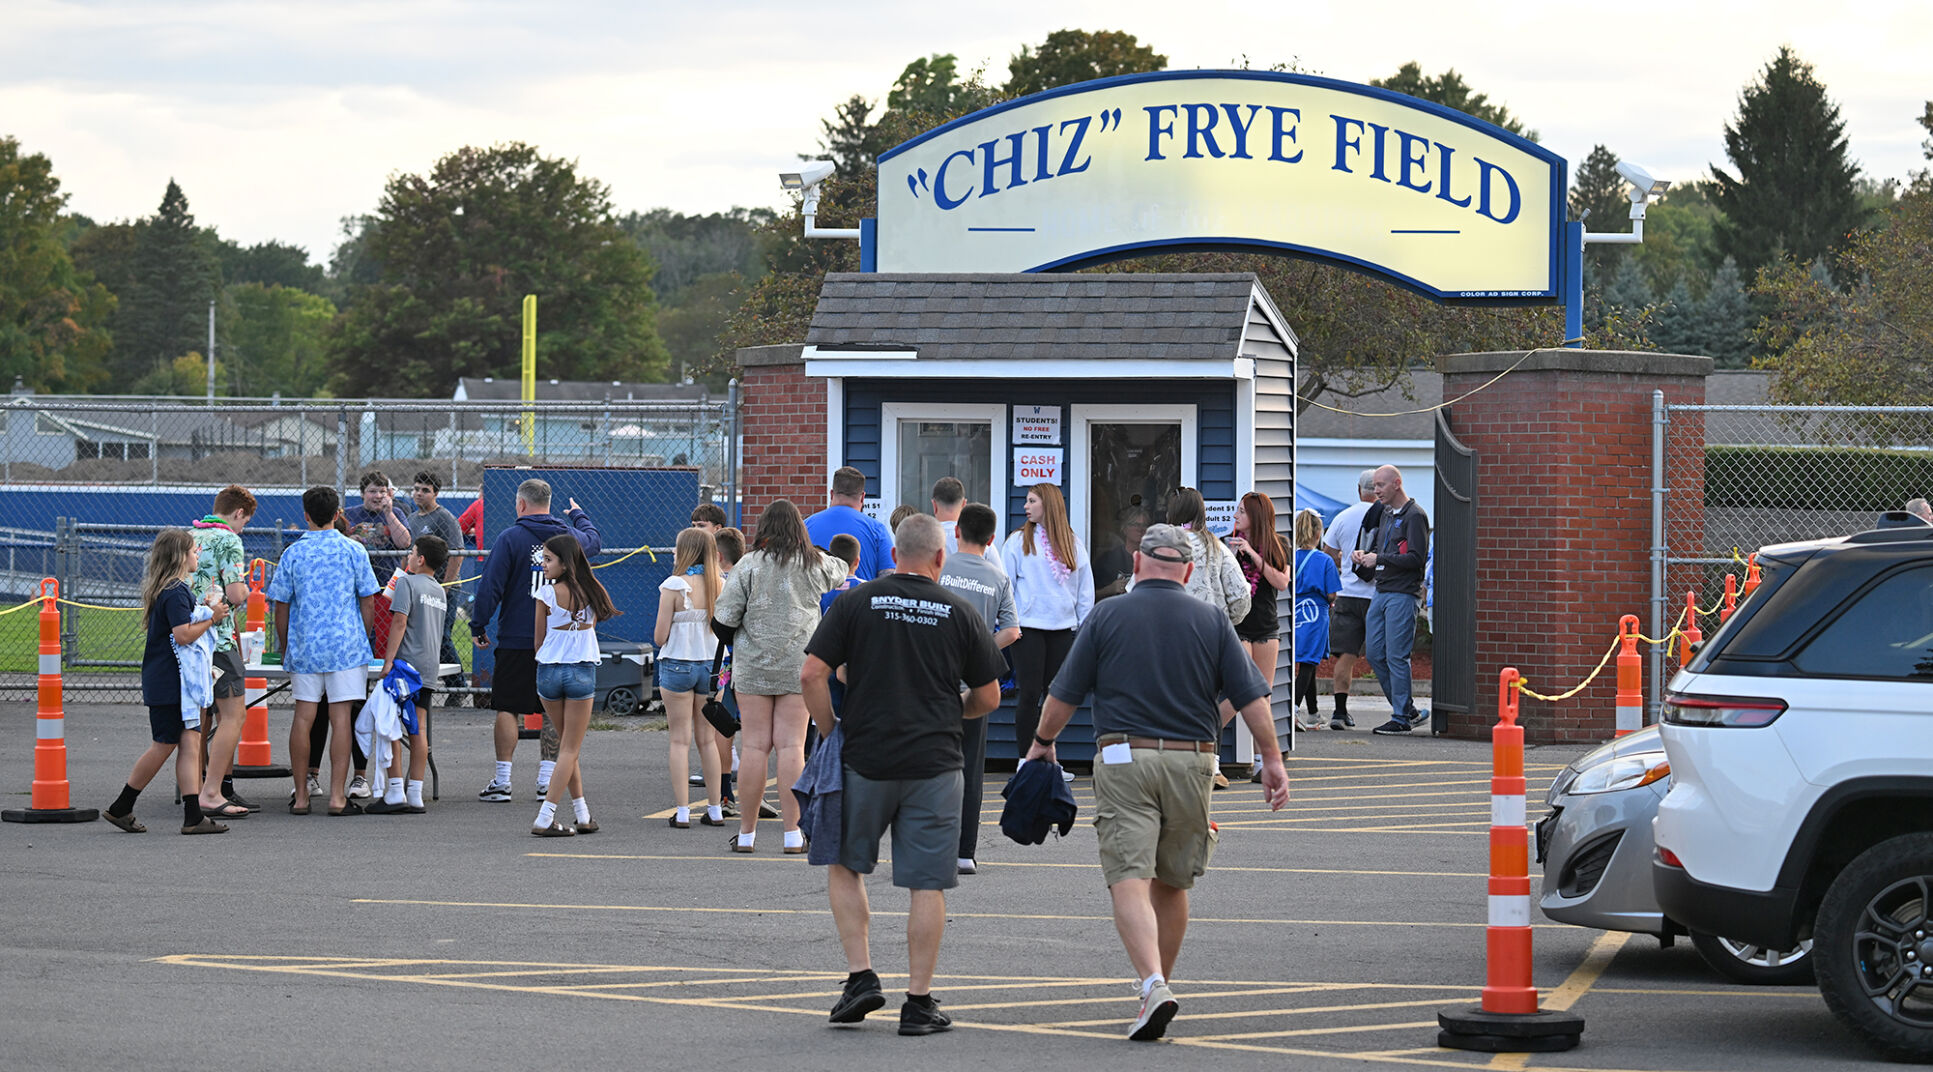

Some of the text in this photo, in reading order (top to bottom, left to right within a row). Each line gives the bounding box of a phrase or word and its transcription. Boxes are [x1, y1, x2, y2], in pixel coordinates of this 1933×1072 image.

[1142, 102, 1304, 164] FRYE
[1329, 113, 1522, 225] FIELD
[1020, 455, 1056, 465] CASH
[1020, 468, 1055, 478] ONLY
[940, 574, 996, 597] #BuiltDifferent
[871, 596, 952, 612] SNYDER BUILT
